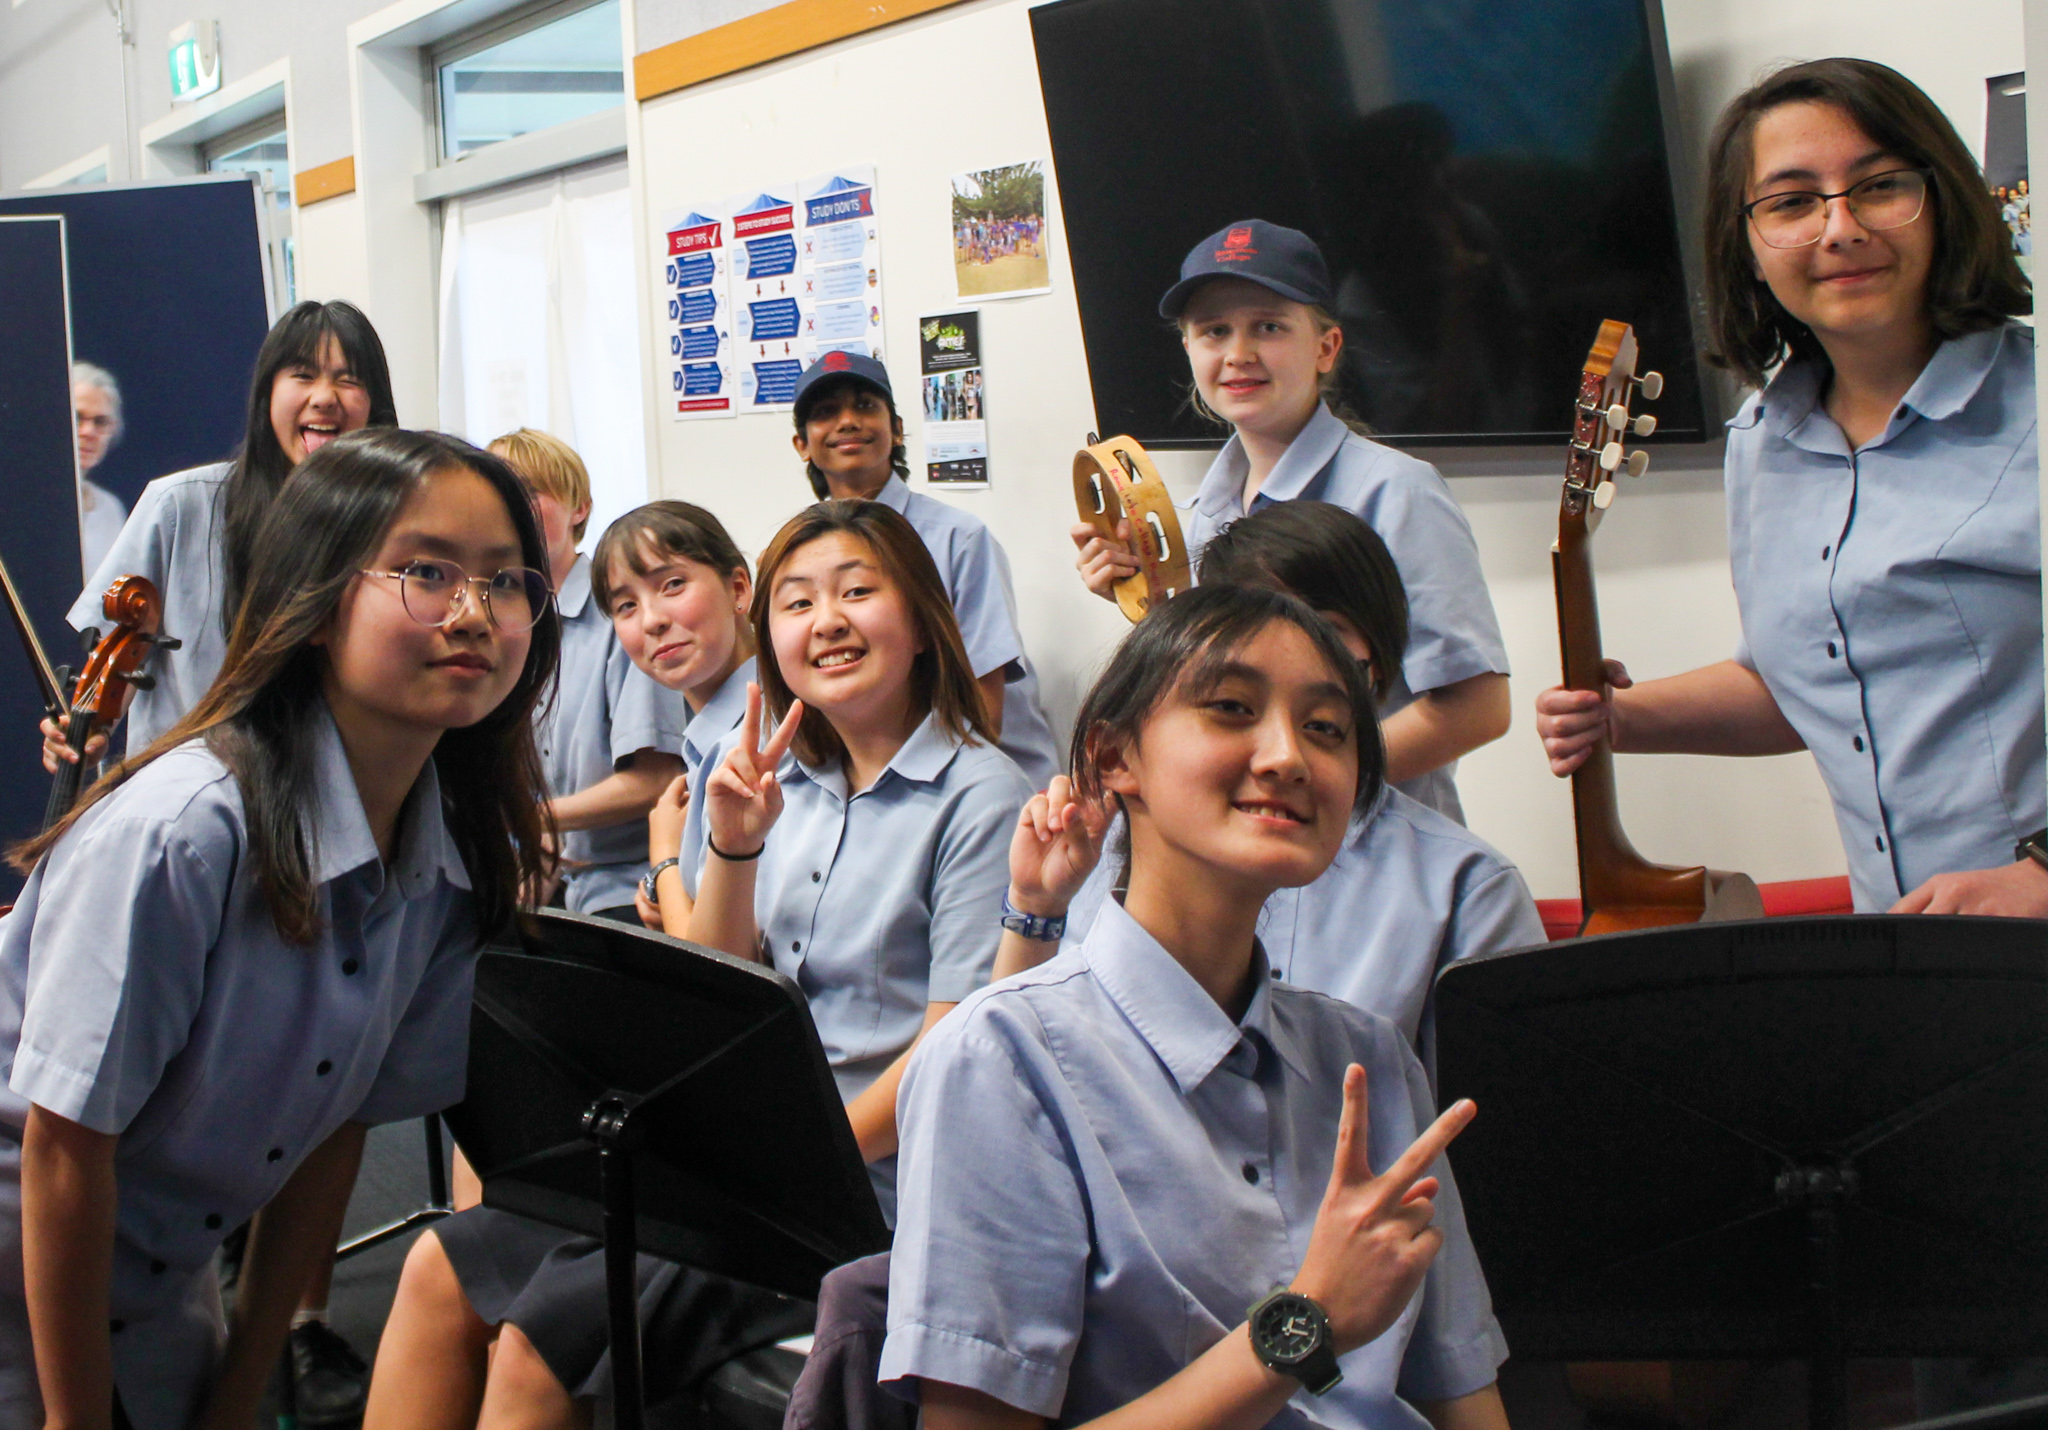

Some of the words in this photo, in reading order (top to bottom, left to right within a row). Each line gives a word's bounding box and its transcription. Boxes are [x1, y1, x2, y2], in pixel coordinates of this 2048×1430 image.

[811, 203, 833, 219] STUDY
[676, 236, 693, 249] STUDY
[694, 233, 707, 245] TIPS
